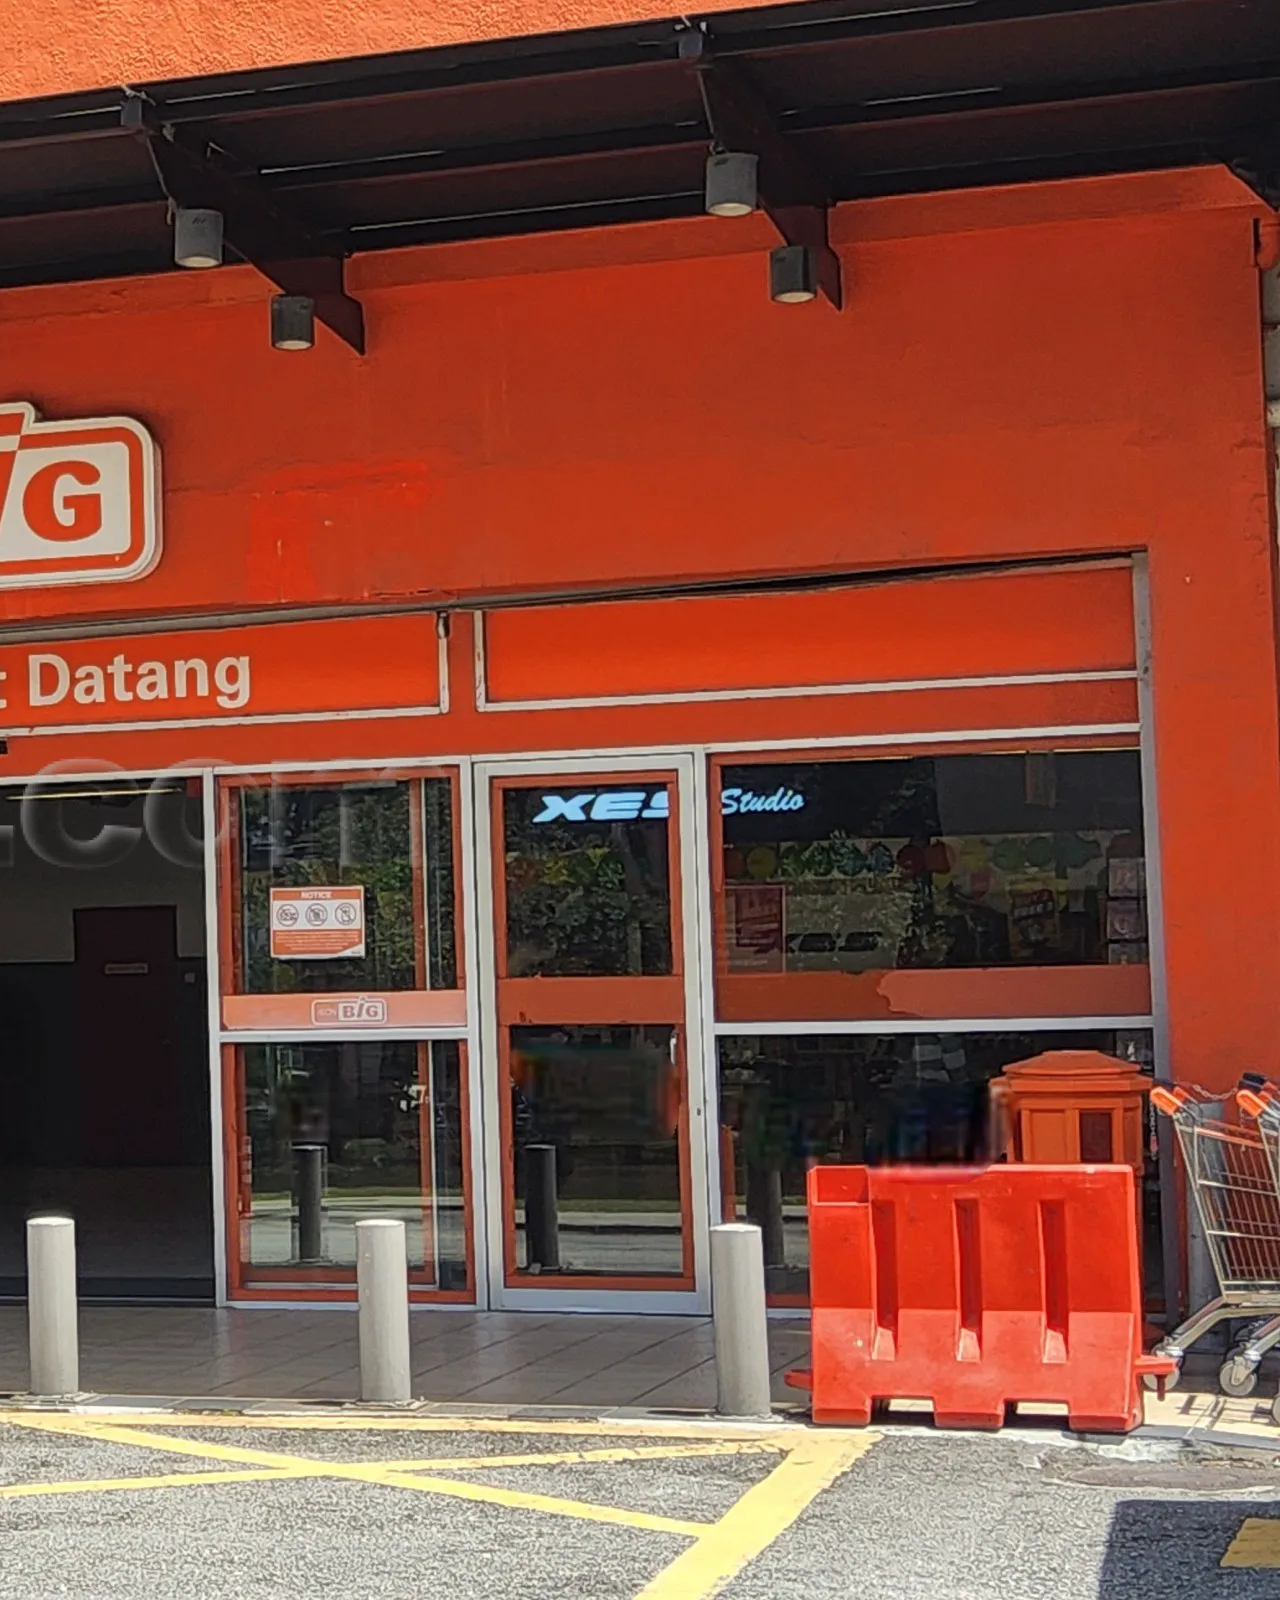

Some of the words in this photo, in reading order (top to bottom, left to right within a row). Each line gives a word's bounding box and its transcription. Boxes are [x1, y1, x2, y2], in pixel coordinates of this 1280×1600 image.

[27, 654, 251, 709] Datang
[721, 786, 804, 814] Studio
[301, 891, 332, 899] NOTICE
